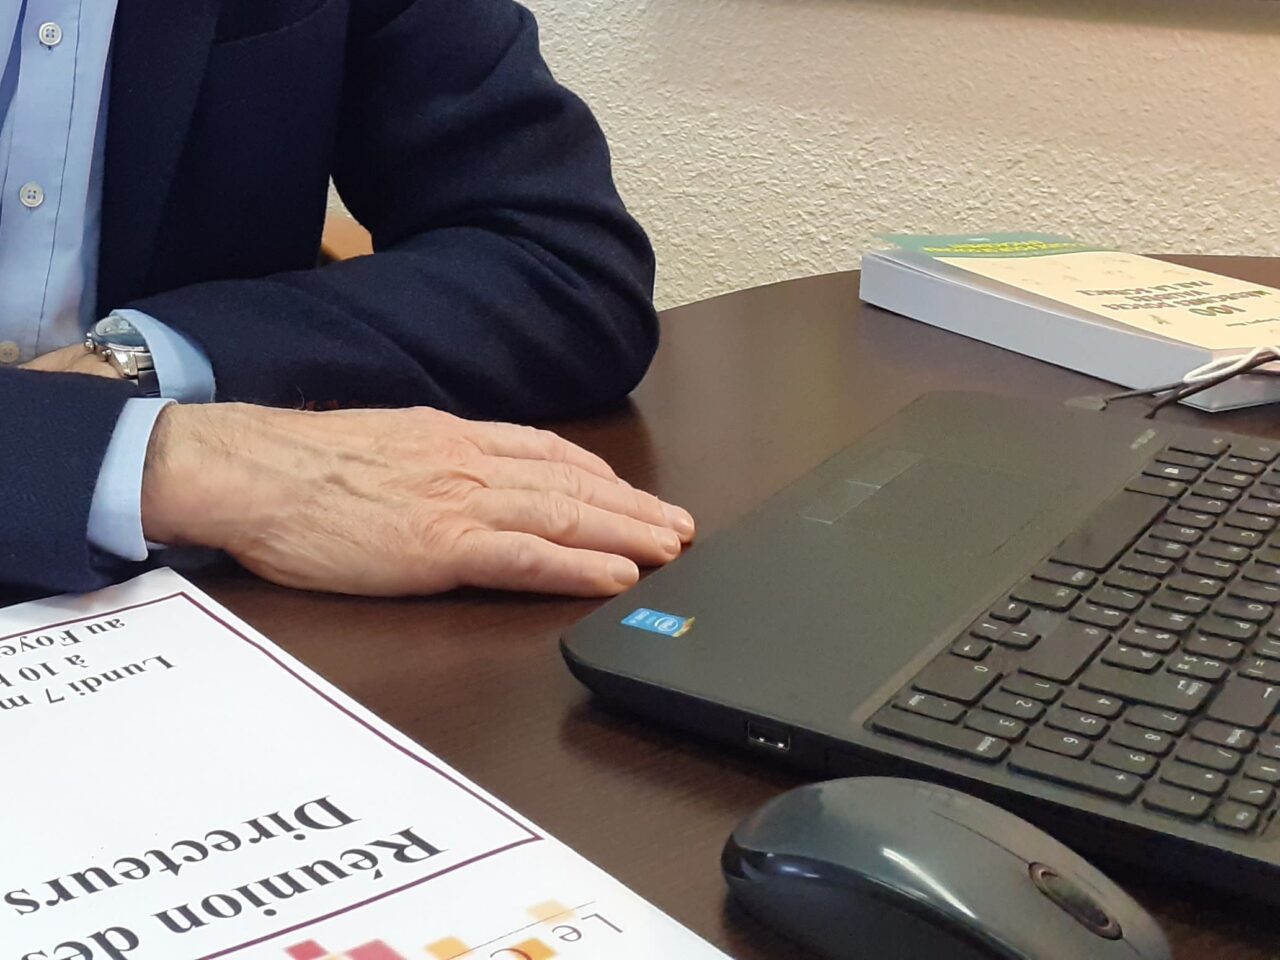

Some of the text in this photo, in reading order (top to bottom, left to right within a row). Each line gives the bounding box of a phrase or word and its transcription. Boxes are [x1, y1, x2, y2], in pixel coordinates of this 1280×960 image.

[1188, 304, 1246, 316] 100
[85, 618, 126, 635] au
[64, 654, 89, 668] à
[18, 662, 60, 681] 10
[67, 655, 177, 696] Lundi
[45, 688, 65, 704] 7
[3, 794, 362, 917] Directeurs
[148, 825, 450, 936] Réunion
[551, 913, 623, 942] Le
